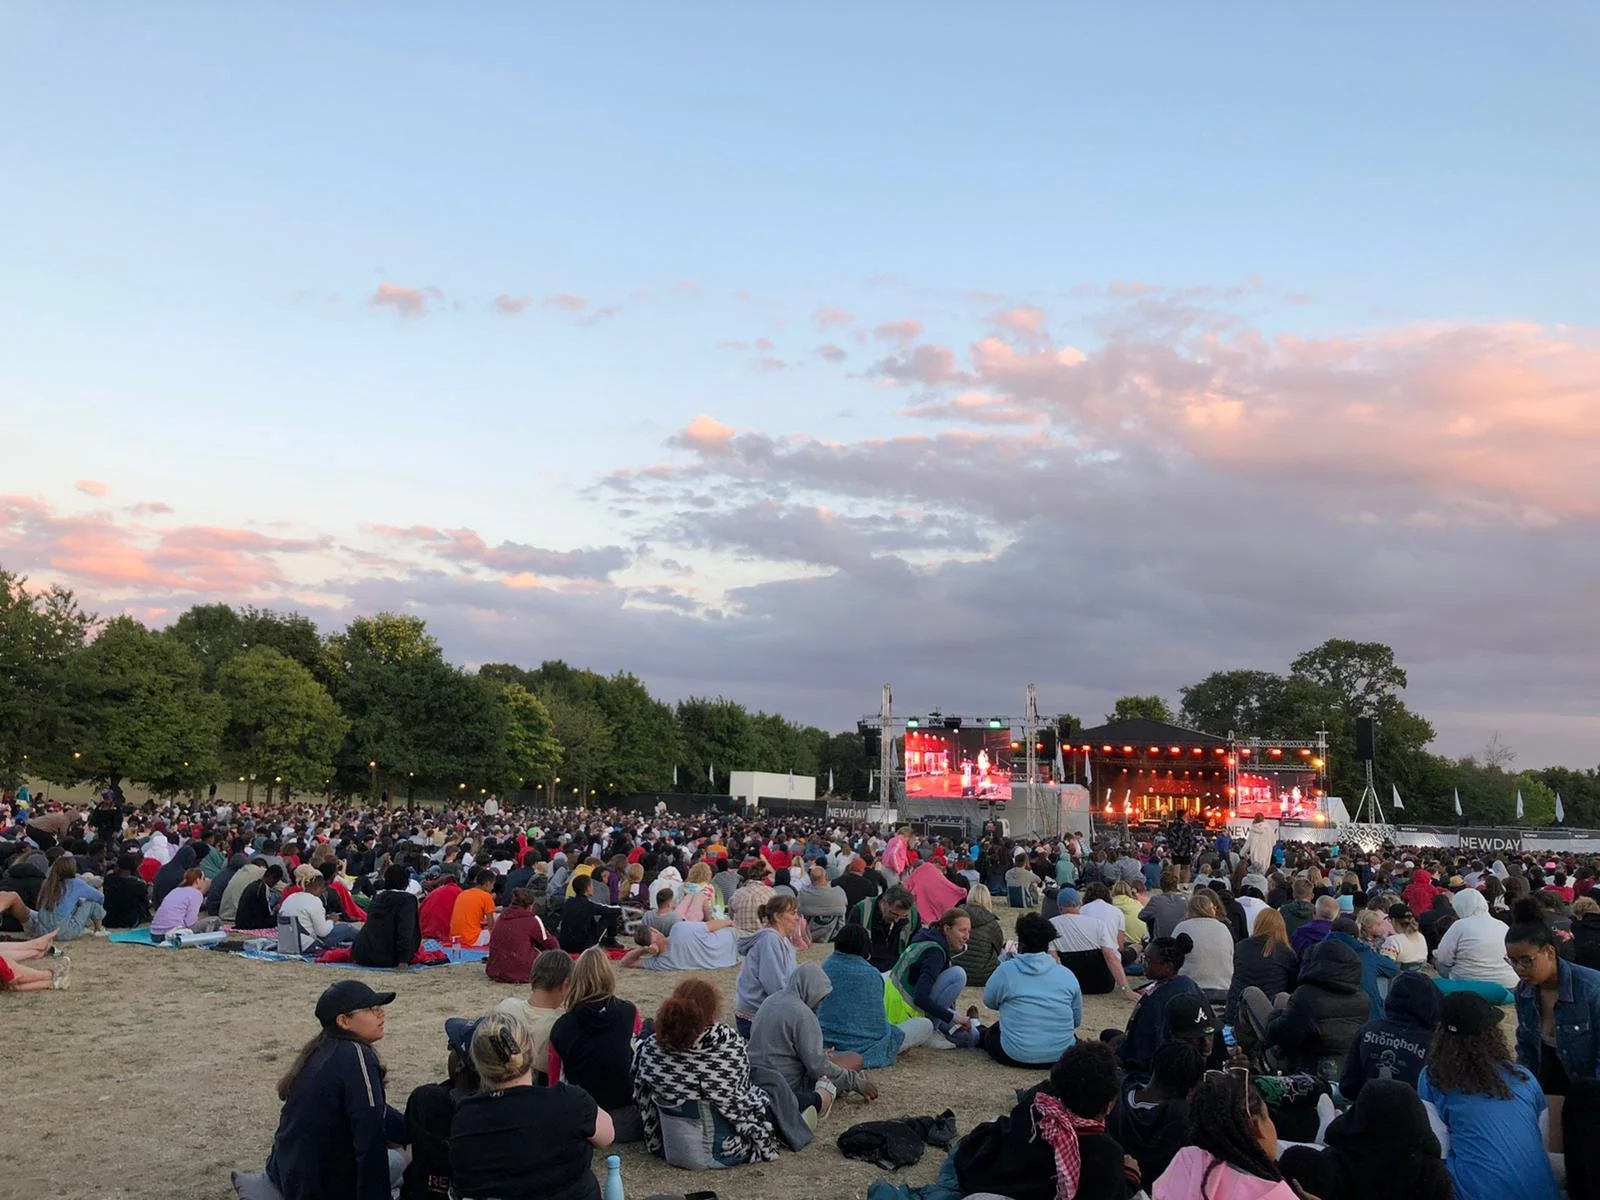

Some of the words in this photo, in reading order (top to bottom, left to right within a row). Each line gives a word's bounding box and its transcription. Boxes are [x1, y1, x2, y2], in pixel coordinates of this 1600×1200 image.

[828, 807, 867, 819] NEWDAY
[1460, 836, 1521, 851] NEWDAY
[1194, 1006, 1208, 1023] A
[1363, 1031, 1426, 1060] Stronghold
